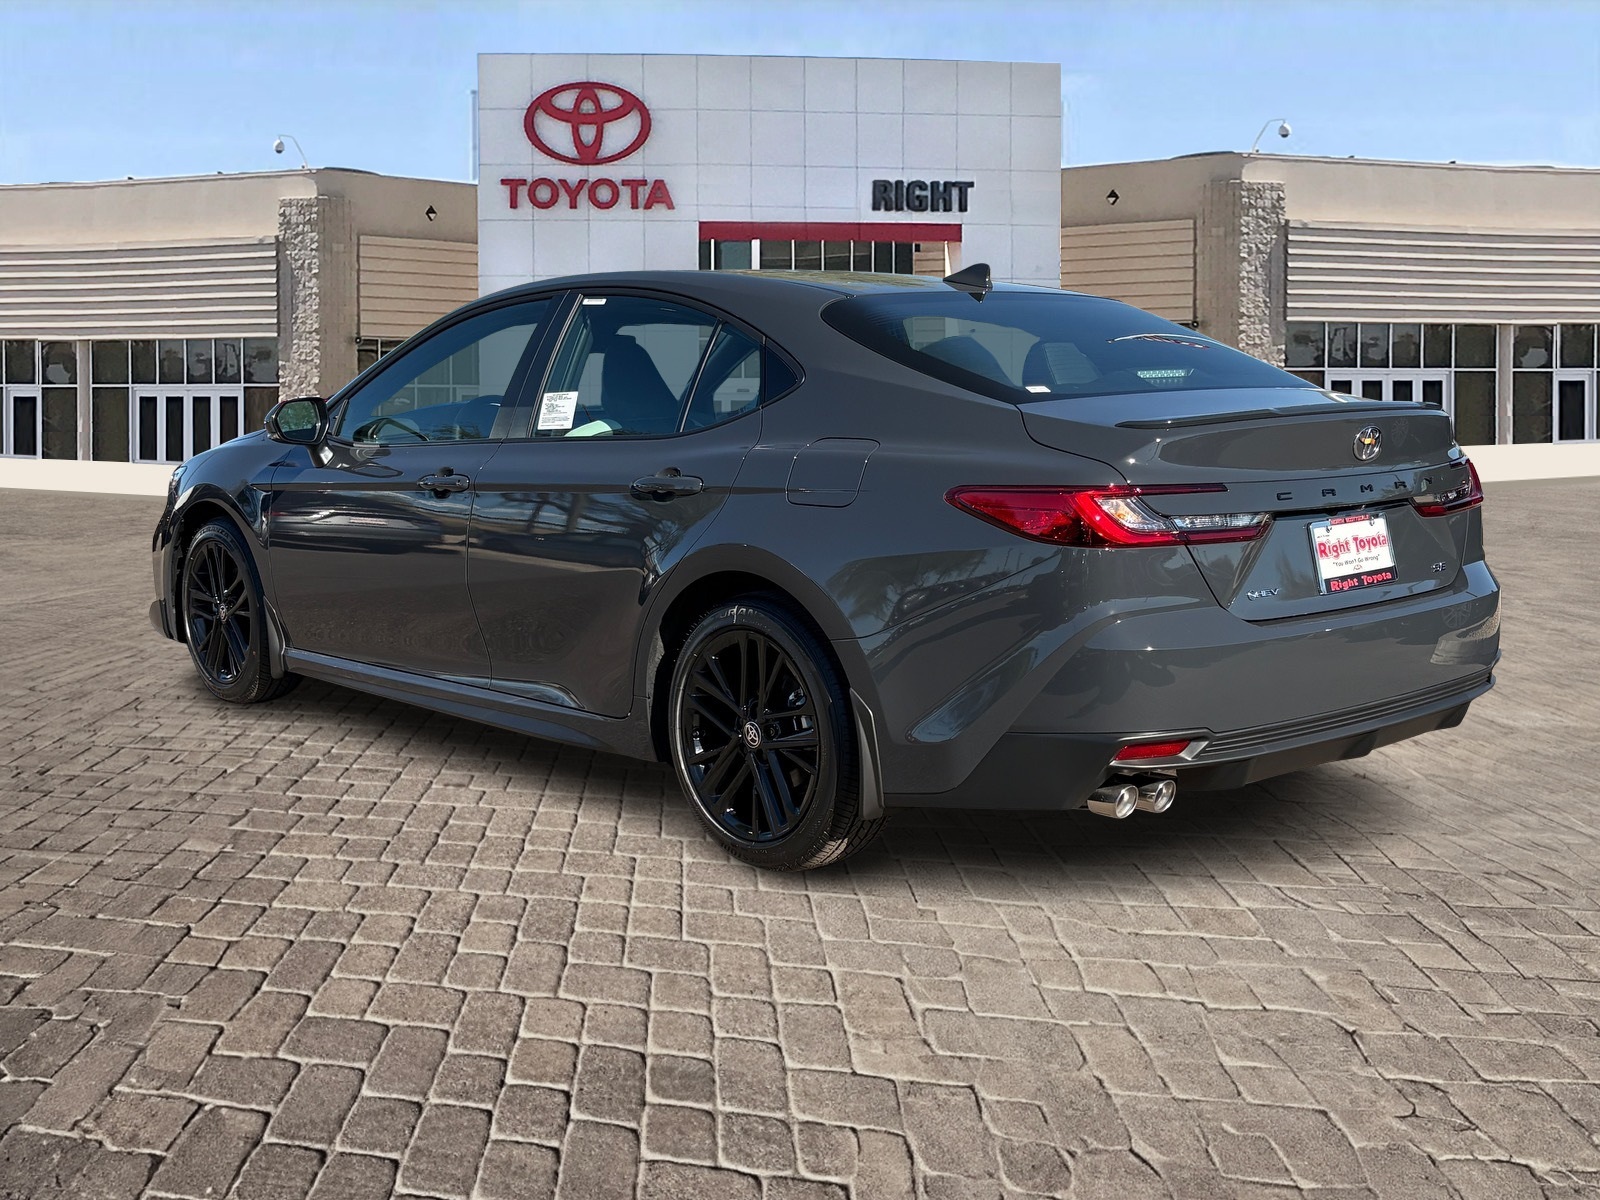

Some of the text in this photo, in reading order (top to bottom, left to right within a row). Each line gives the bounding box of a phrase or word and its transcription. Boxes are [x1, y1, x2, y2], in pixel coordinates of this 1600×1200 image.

[500, 178, 676, 210] TOYOTA
[872, 179, 975, 213] RIGHT
[1276, 476, 1433, 500] CAMRY
[1317, 533, 1388, 559] Right Toyota
[1330, 572, 1392, 591] Right Toyota
